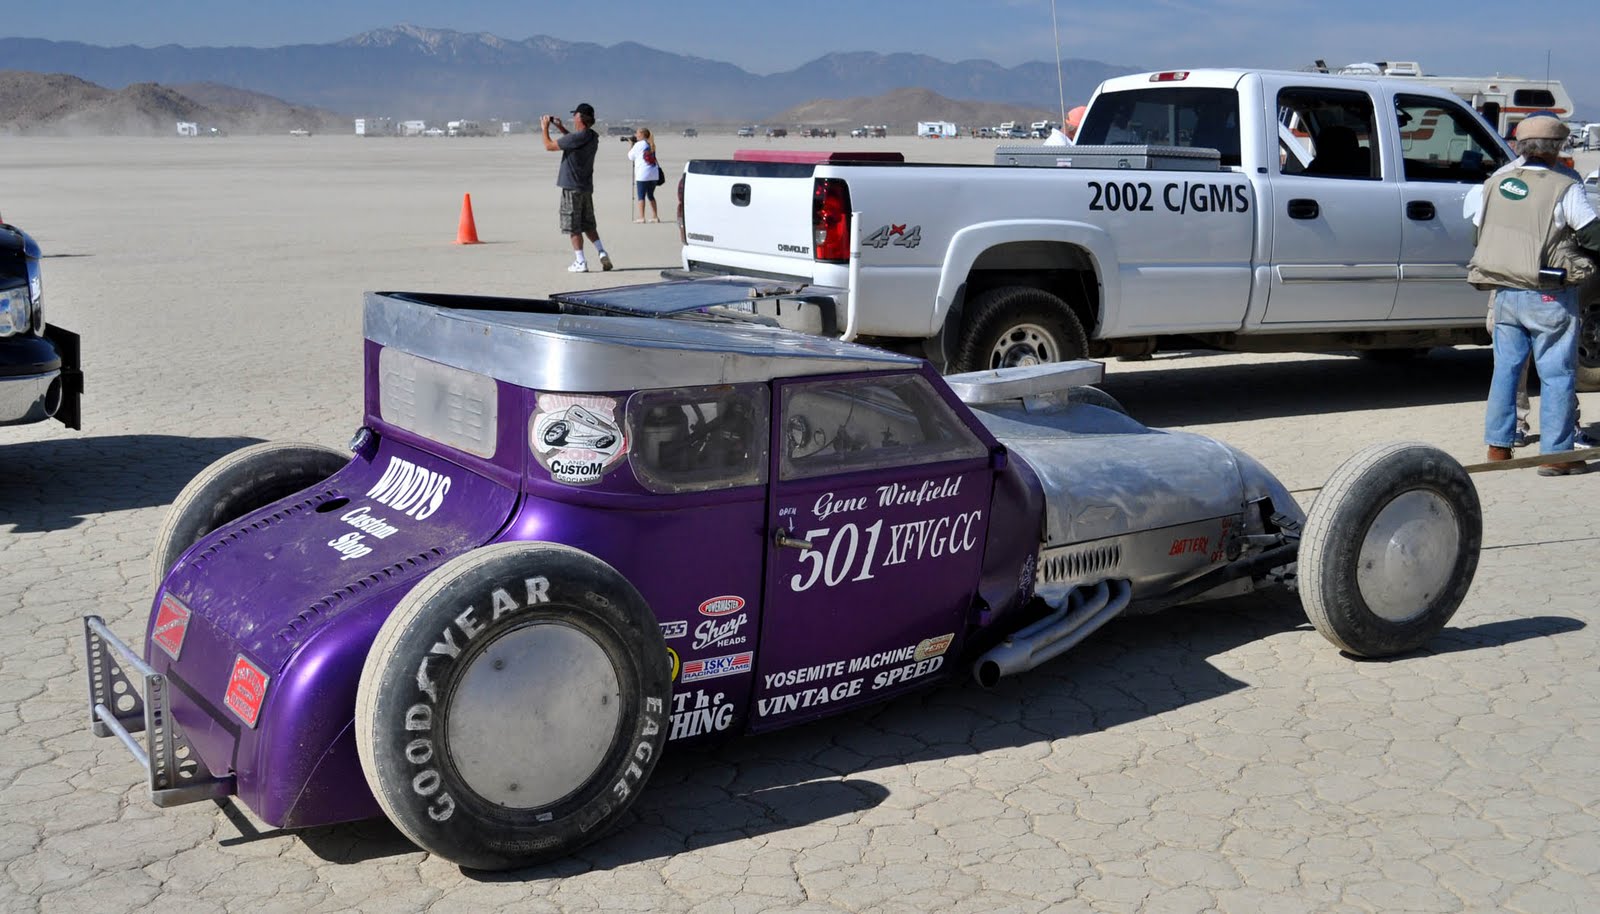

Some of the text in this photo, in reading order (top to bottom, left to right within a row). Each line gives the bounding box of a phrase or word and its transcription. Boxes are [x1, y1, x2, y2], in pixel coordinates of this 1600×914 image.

[1088, 181, 1249, 215] 2002 C/GMS
[1500, 181, 1527, 196] Leica
[366, 456, 452, 521] WINDYS
[556, 473, 602, 484] SSOCIATION
[778, 507, 797, 517] OPEN
[811, 475, 963, 521] Gene Winfield
[340, 506, 399, 539] Custom
[327, 532, 374, 561] Shop
[790, 510, 982, 592] 501 XFVGCC
[1168, 536, 1209, 556] BATTERY
[692, 613, 748, 650] Sharp
[717, 636, 747, 648] HEADS
[684, 663, 750, 679] RACING CAMS
[703, 656, 734, 671] ISKY
[764, 660, 846, 690] YOSEMITE
[848, 645, 916, 675] MACHINE
[673, 689, 725, 713] The
[757, 656, 944, 718] VINTAGE SPEED
[613, 696, 663, 804] EAGLE
